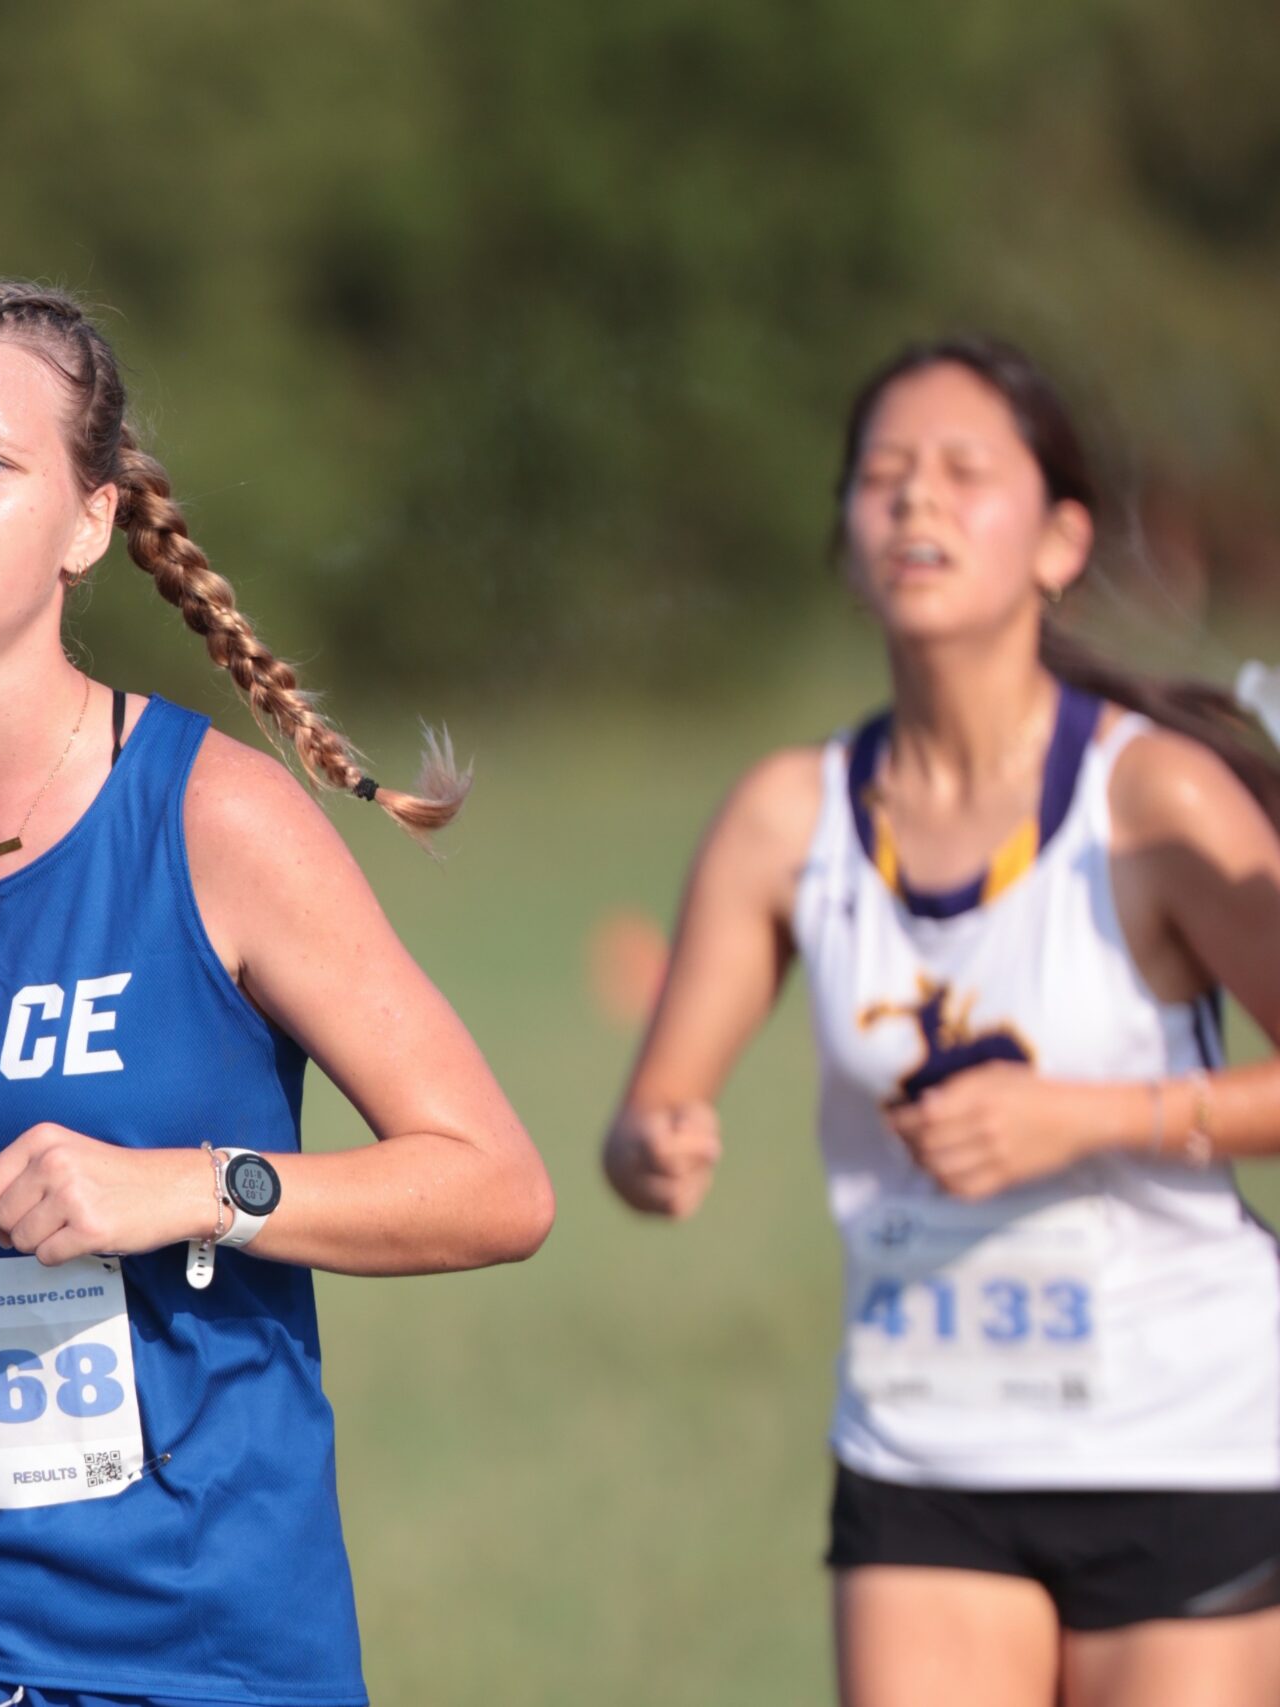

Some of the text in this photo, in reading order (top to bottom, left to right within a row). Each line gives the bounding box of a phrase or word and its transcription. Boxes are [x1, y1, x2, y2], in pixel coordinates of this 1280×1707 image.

[242, 1178, 266, 1191] 7:07
[858, 1277, 1092, 1343] 4133
[13, 1467, 78, 1485] RESULTS
